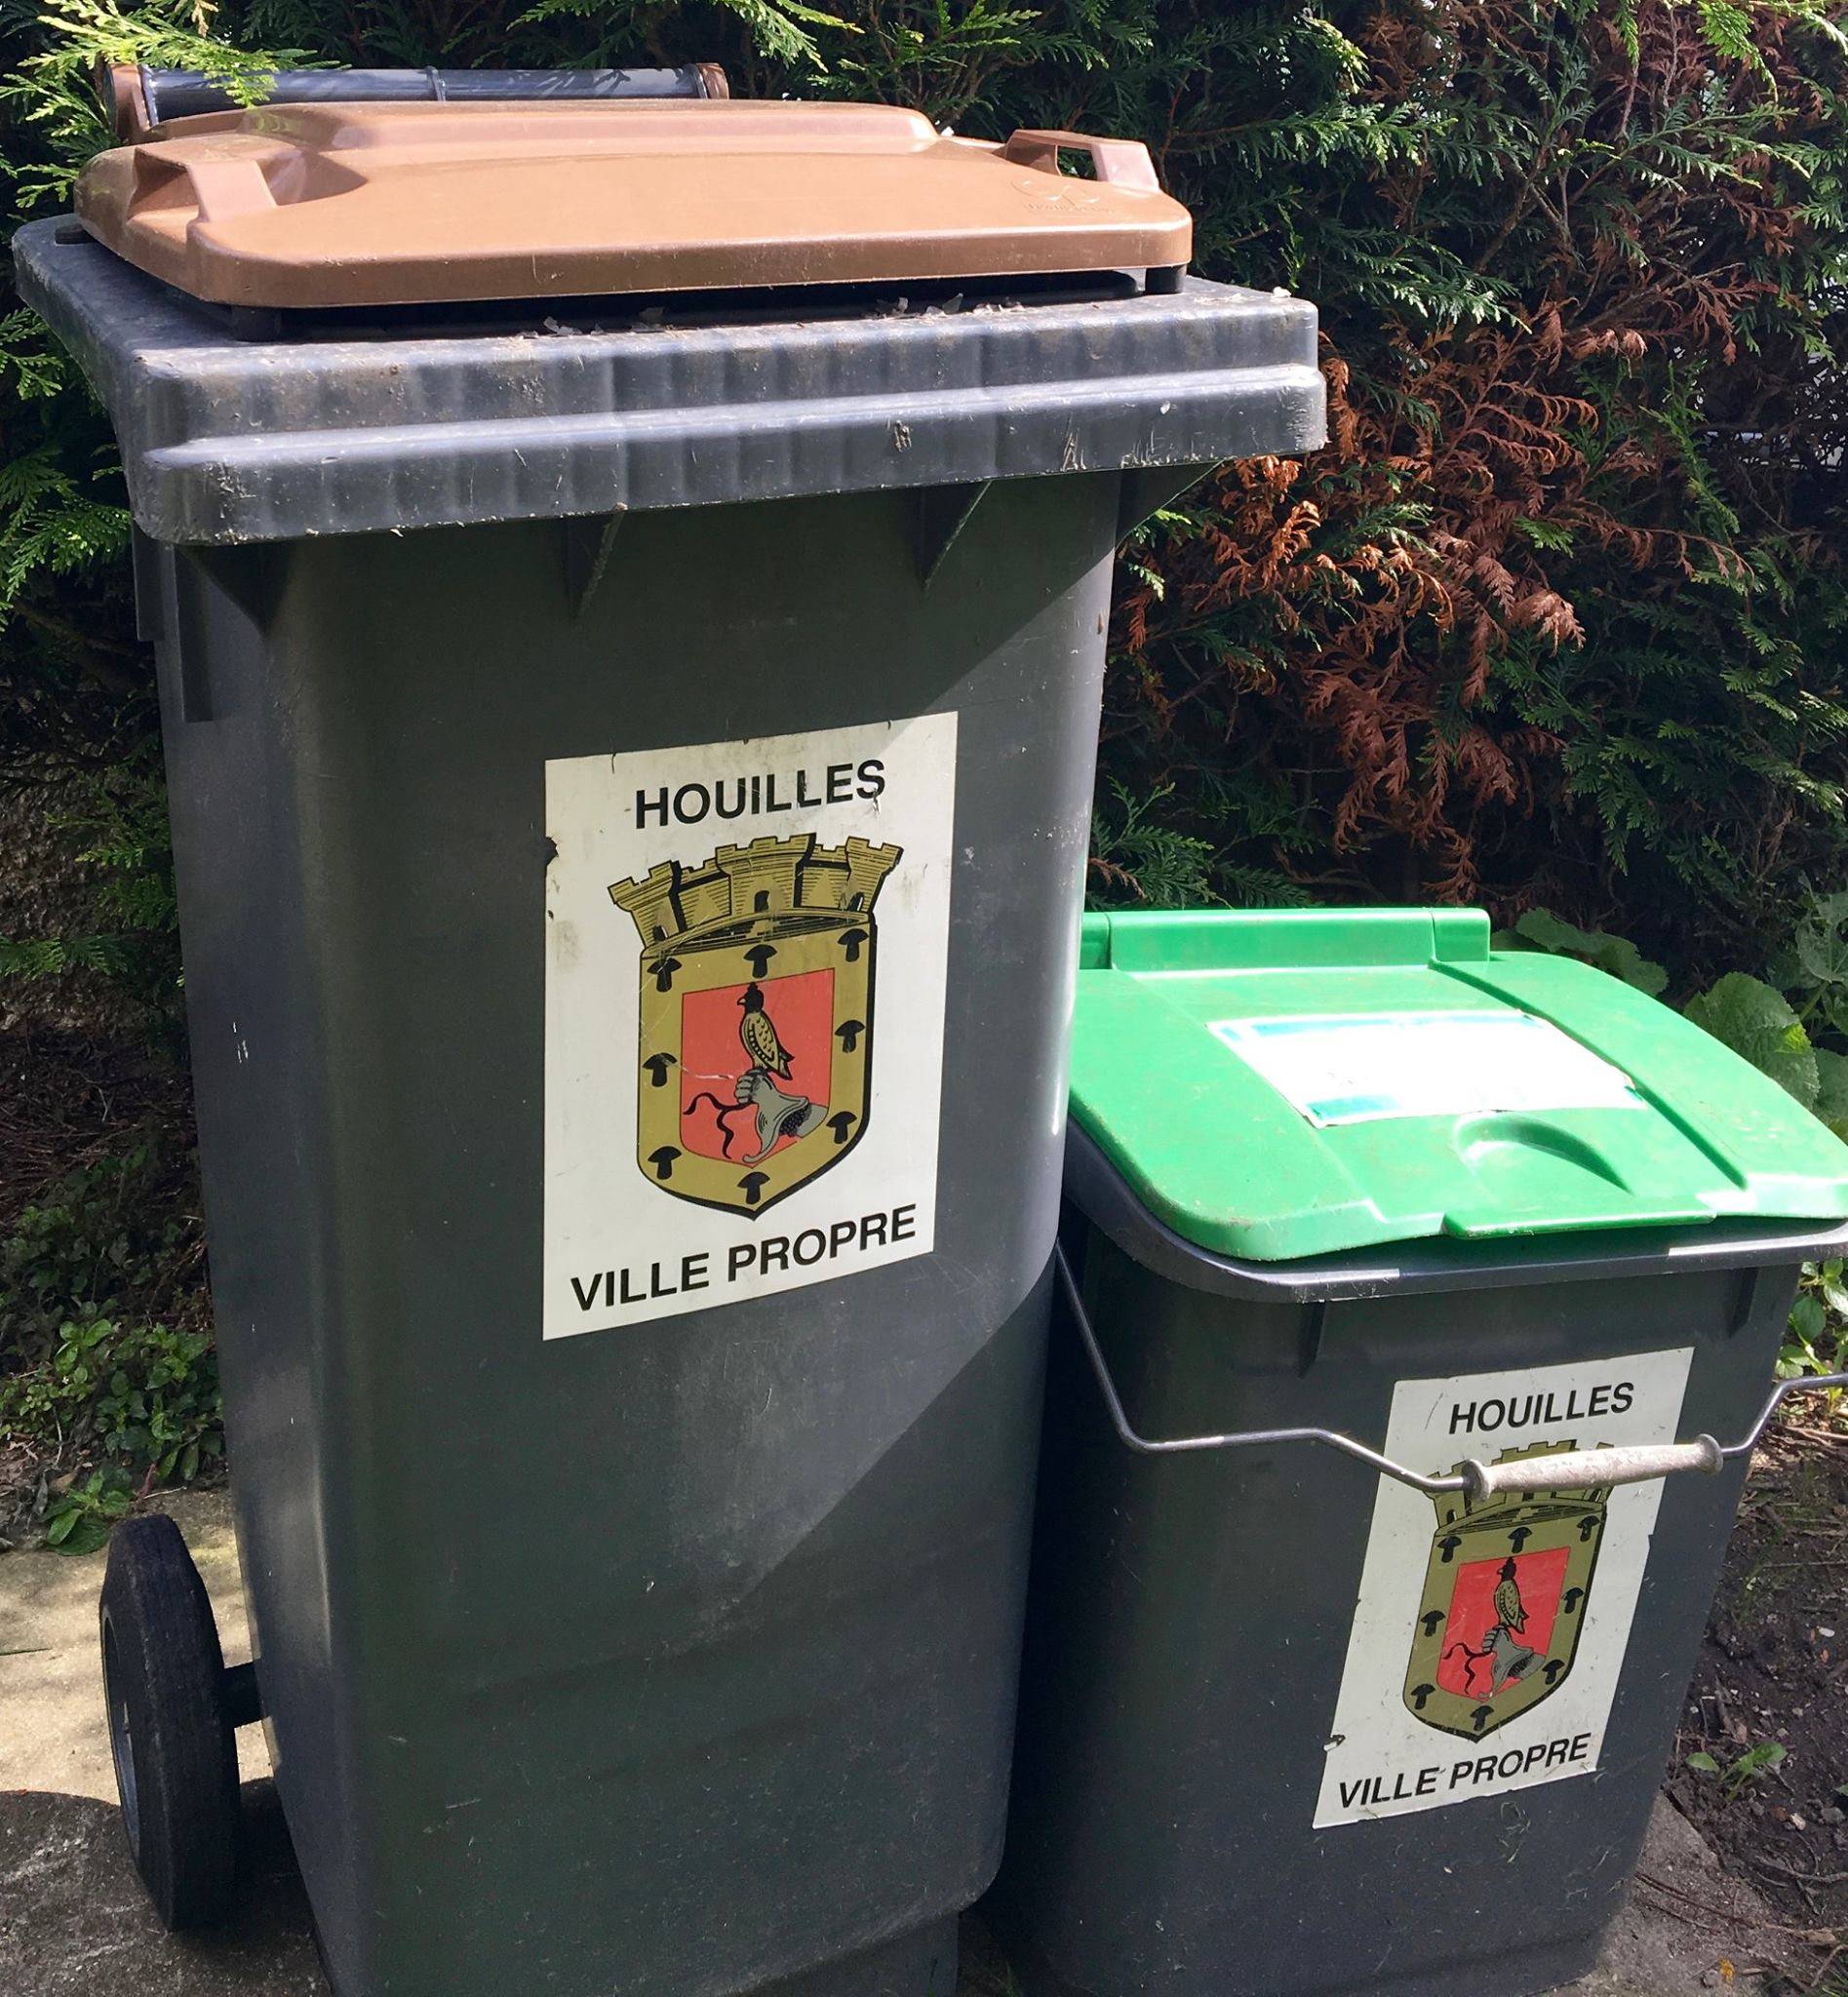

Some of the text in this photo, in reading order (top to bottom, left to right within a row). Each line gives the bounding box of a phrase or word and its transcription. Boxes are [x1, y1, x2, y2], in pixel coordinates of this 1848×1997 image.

[636, 760, 885, 829] HOUILLES
[570, 1203, 918, 1312] VILLE PROPRE
[1449, 1382, 1634, 1434] HOUILLES
[1339, 1733, 1592, 1808] VILLE PROPRE
